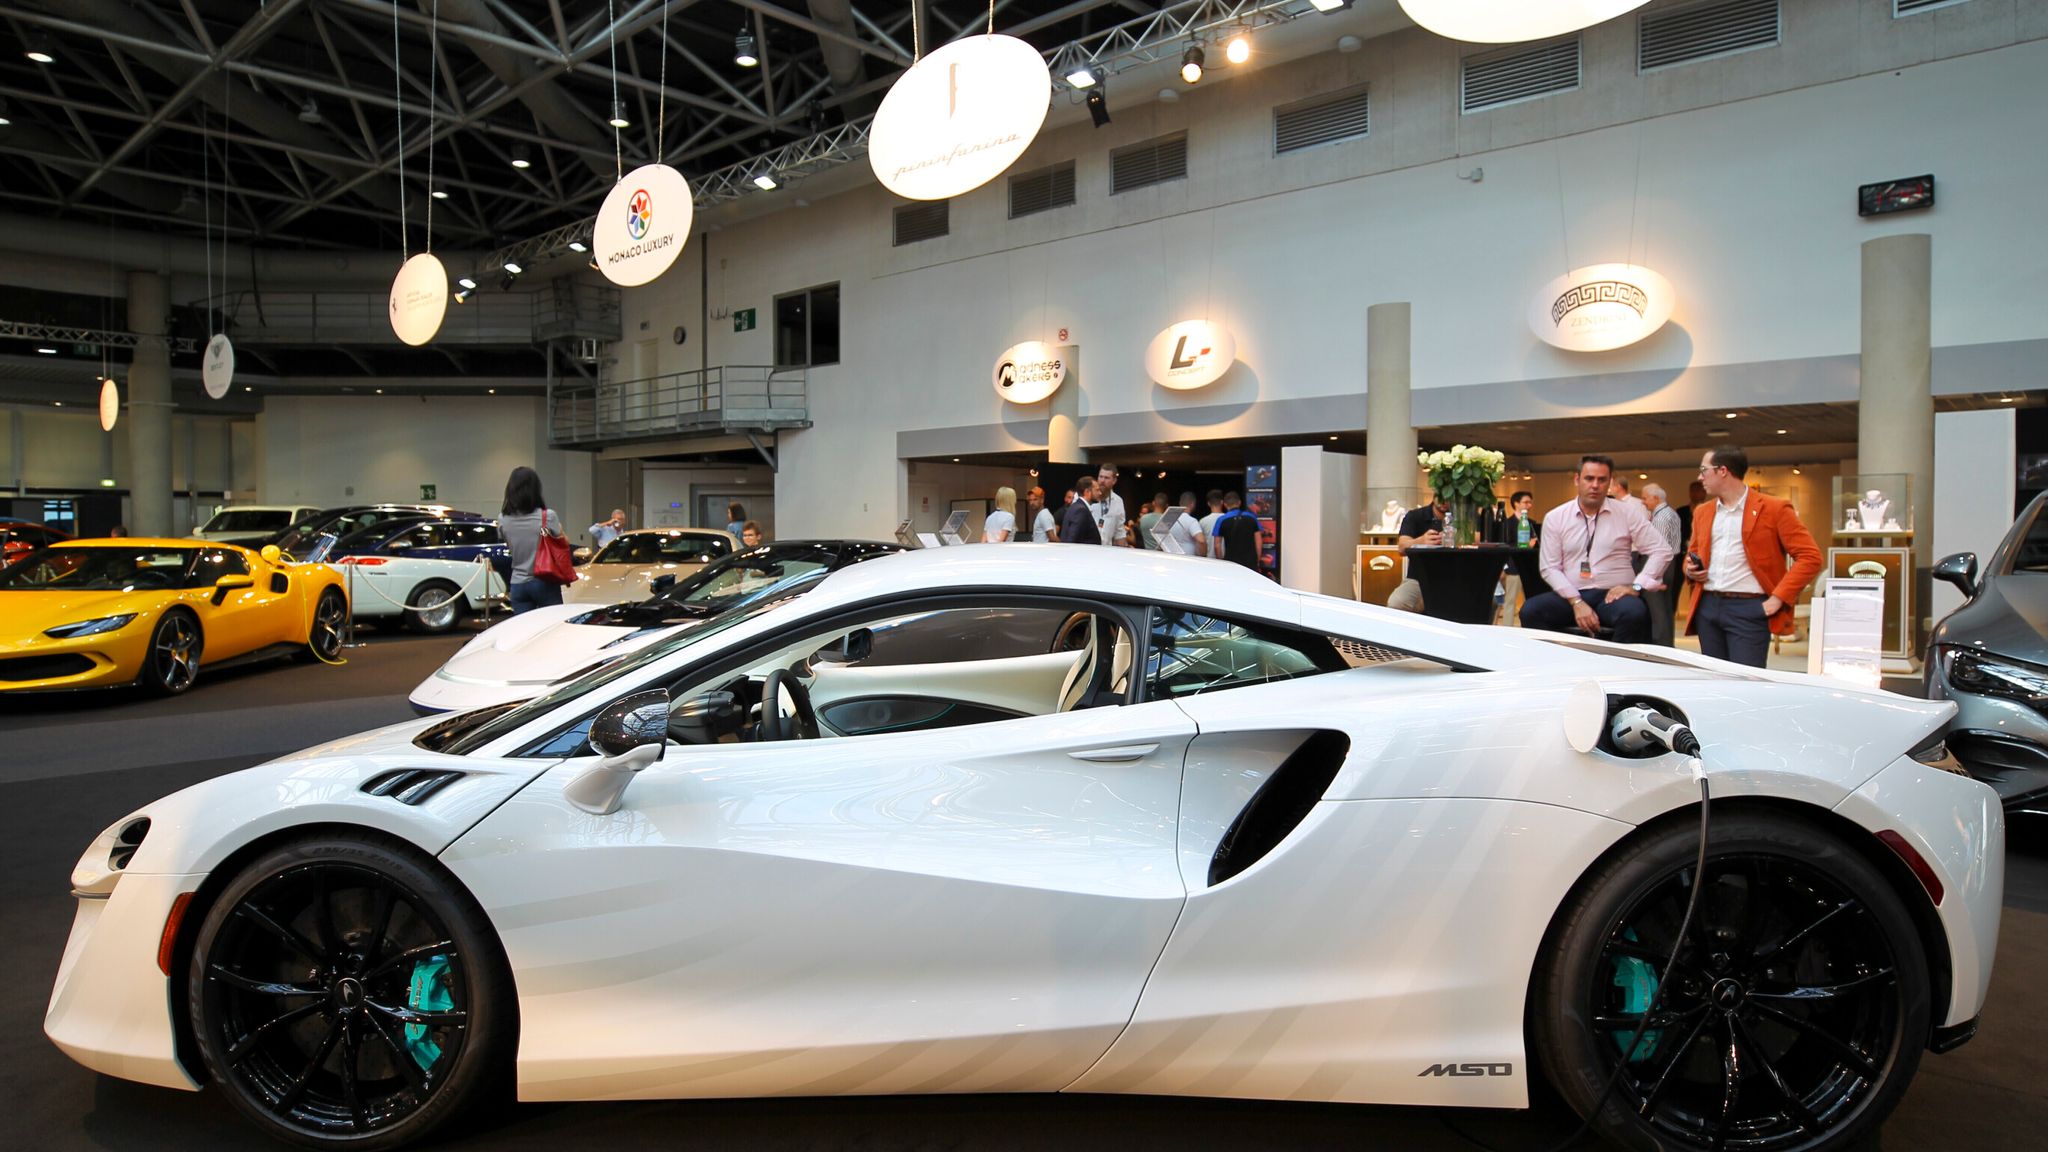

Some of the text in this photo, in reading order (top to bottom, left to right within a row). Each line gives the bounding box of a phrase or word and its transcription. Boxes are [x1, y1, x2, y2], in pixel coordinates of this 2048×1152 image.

[893, 133, 1022, 182] pininfarina
[608, 234, 674, 265] MONACO LUXURY
[1417, 1063, 1512, 1076] MSO
